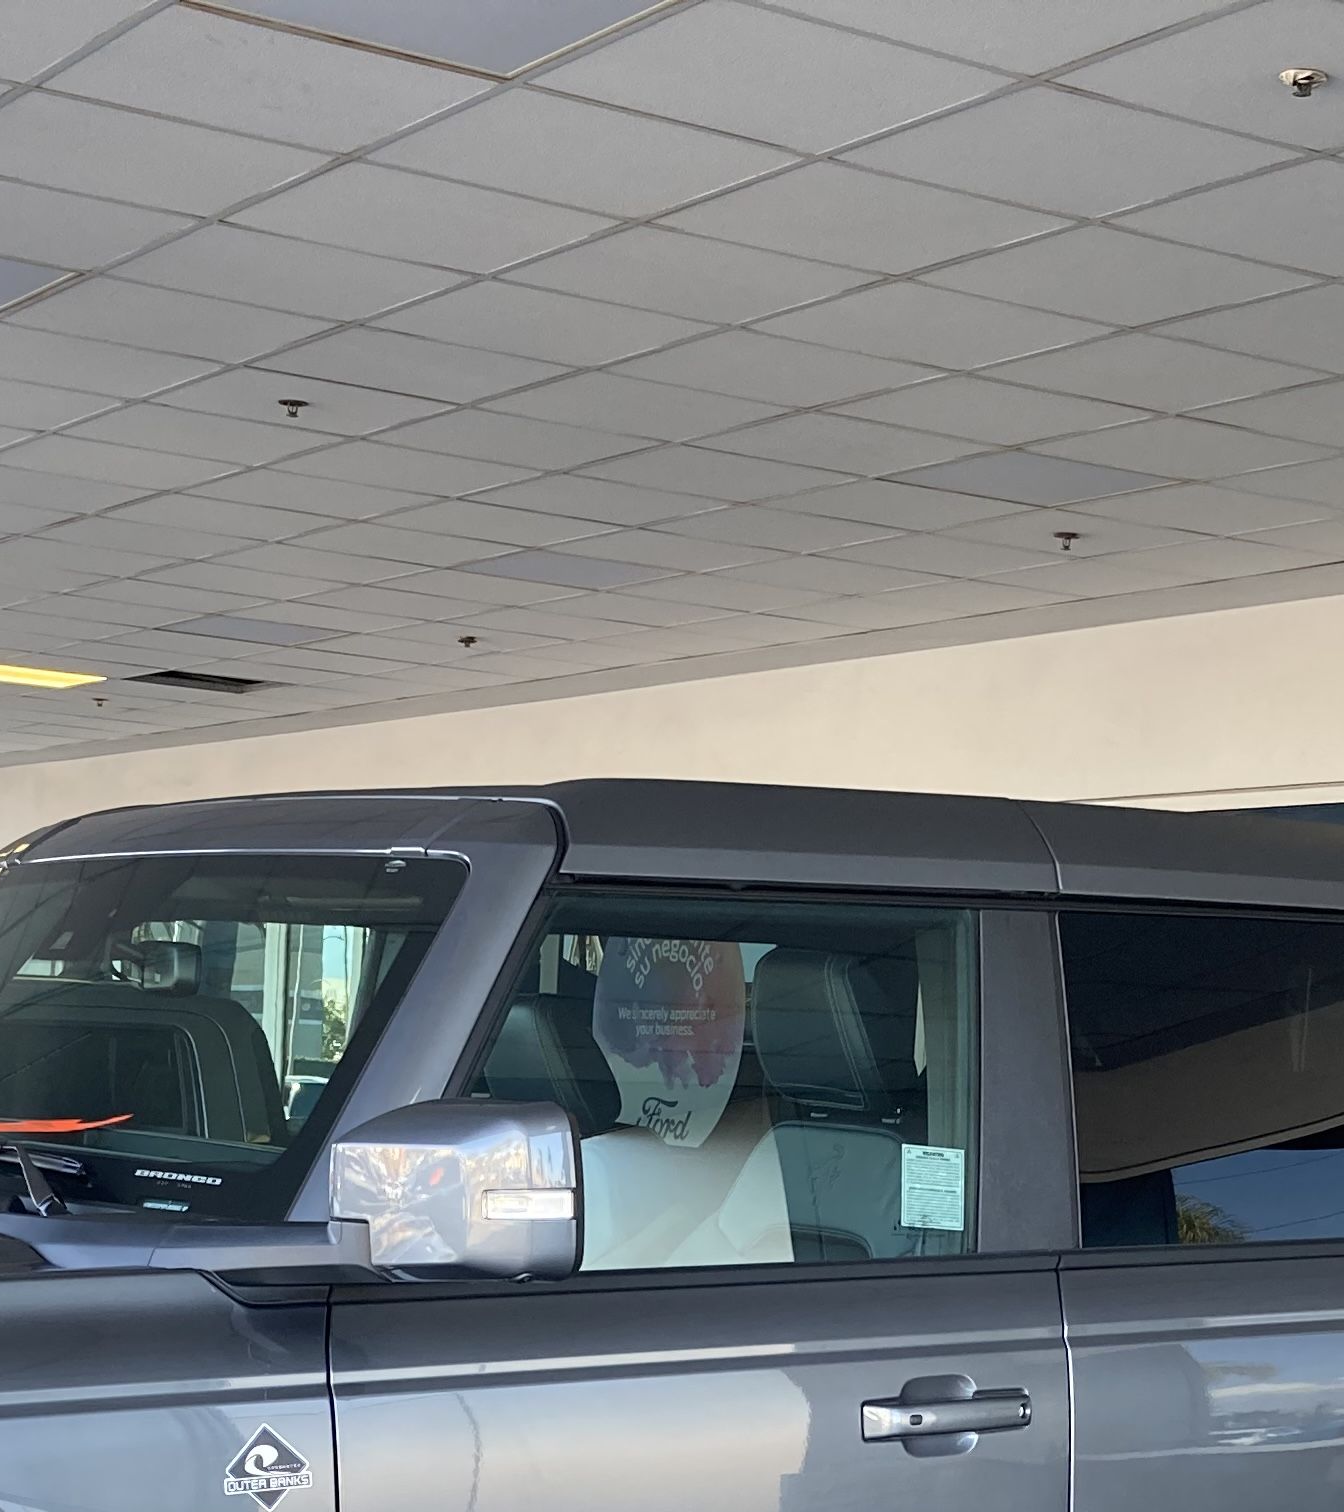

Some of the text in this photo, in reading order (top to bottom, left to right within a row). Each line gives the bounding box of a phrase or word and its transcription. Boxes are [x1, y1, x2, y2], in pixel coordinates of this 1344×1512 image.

[637, 1096, 693, 1140] Ford
[135, 1169, 222, 1186] BRONCO
[227, 1475, 309, 1492] OUTER BANKS
